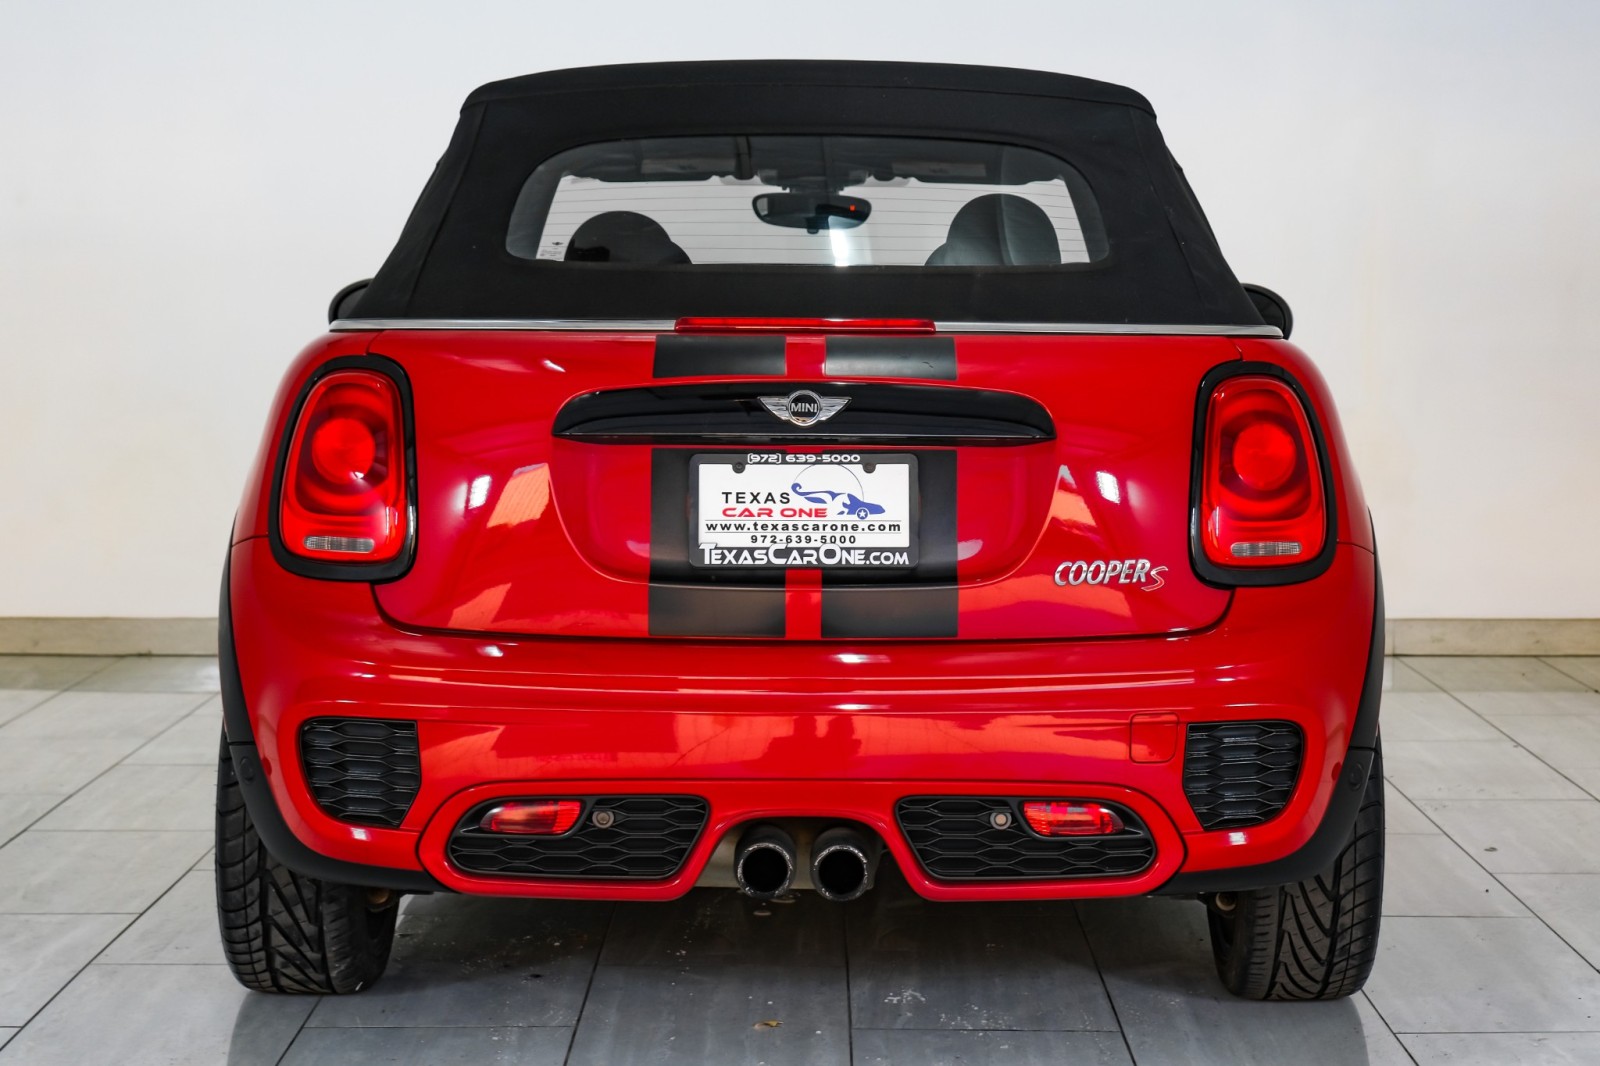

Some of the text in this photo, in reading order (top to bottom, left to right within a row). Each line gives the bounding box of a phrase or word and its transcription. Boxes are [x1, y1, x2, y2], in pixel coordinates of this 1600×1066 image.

[791, 403, 818, 413] MINI
[785, 454, 861, 463] 639-5000
[722, 491, 791, 504] TEXAS
[722, 507, 828, 518] CAR ONE
[705, 521, 901, 532] www.texascarone.com
[750, 535, 857, 544] 972-639-5000
[1054, 558, 1151, 586] COOPER
